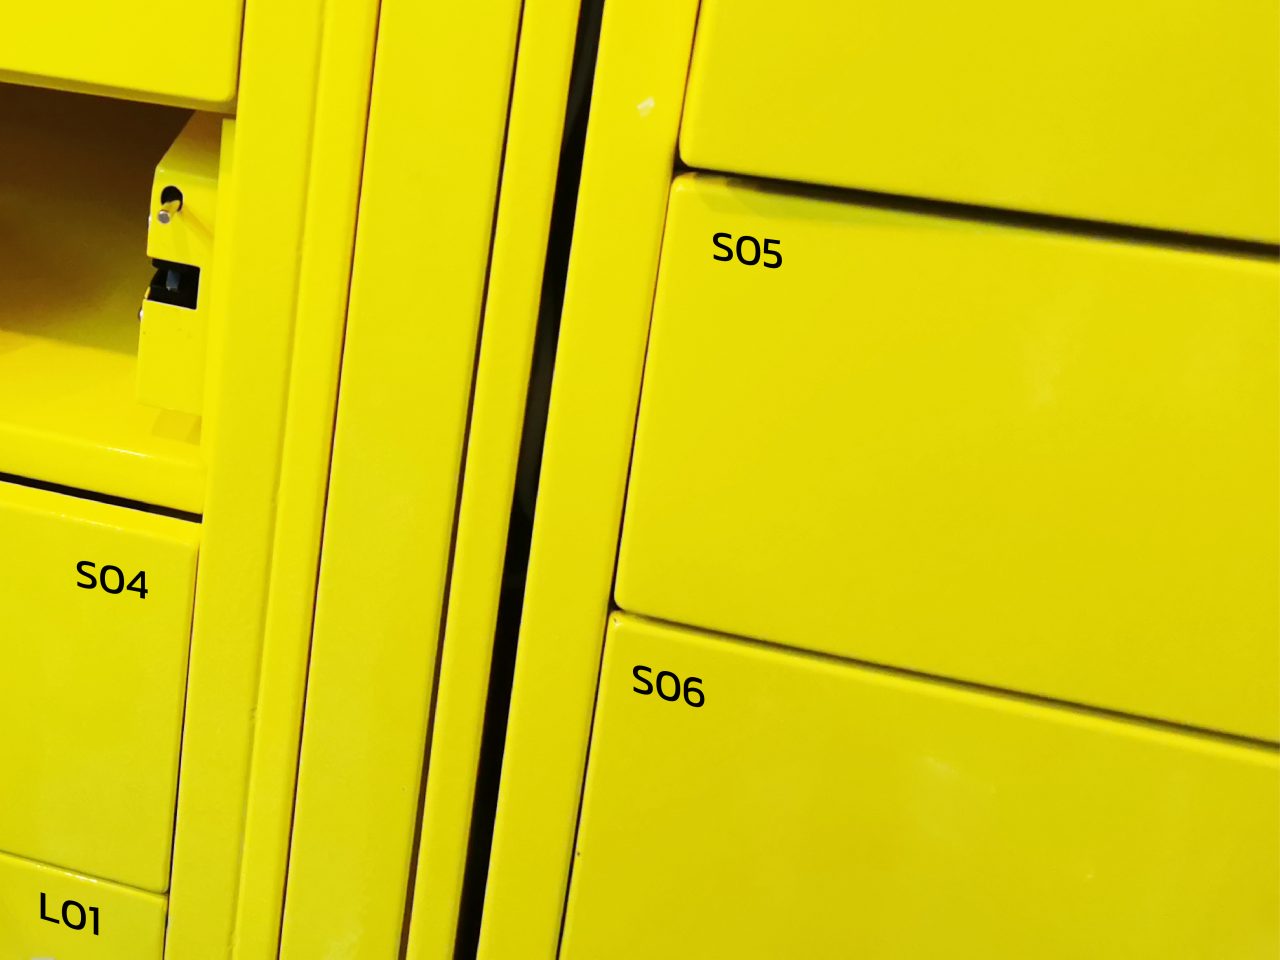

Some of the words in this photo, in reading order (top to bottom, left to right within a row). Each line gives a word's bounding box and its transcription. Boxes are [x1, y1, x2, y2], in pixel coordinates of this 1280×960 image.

[712, 232, 783, 269] S05
[76, 560, 149, 600] S04
[632, 665, 705, 708] S06
[40, 892, 99, 936] L01
